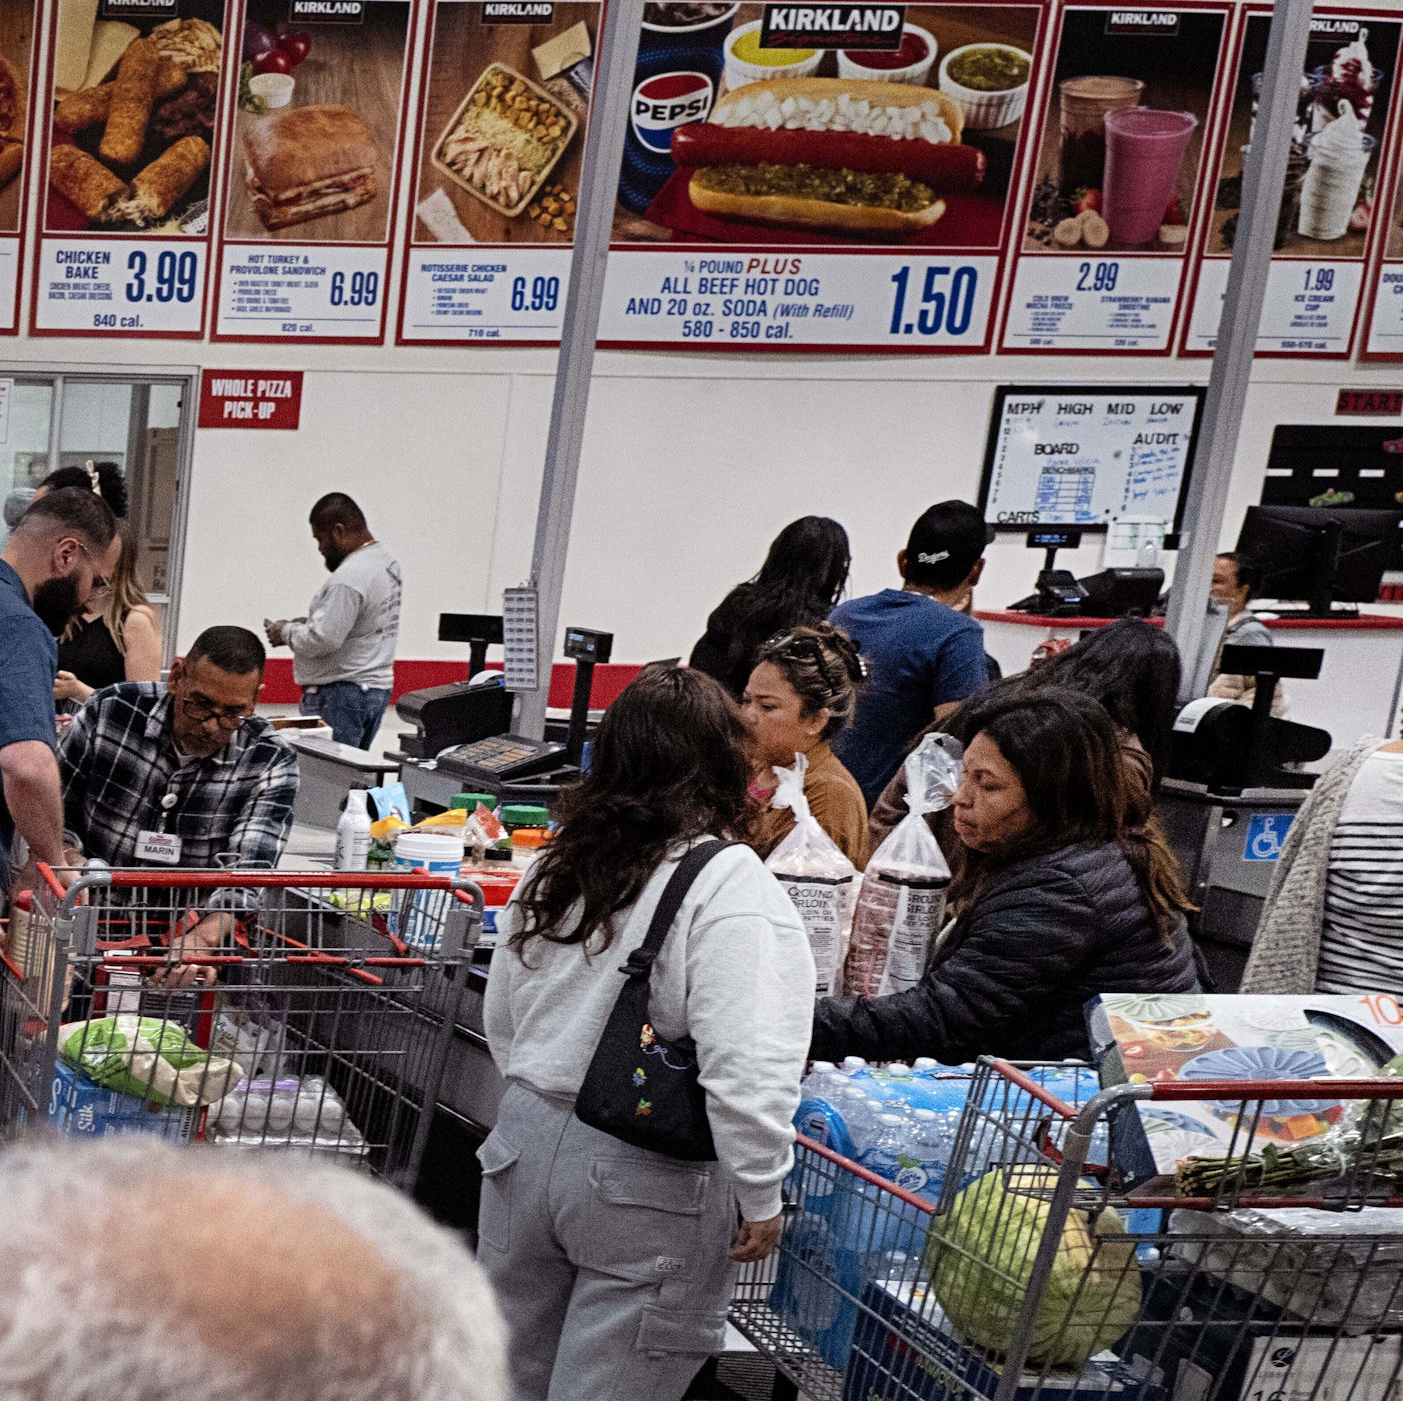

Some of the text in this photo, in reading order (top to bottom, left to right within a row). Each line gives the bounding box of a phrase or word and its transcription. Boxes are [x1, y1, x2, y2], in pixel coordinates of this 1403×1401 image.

[294, 3, 361, 15] KIRKLAND
[484, 4, 552, 16] KIRKLAND
[768, 8, 900, 31] KIRKLAND
[1111, 13, 1177, 26] KIRKLAND
[635, 97, 709, 120] PEPSI
[56, 250, 111, 264] CHICKEN
[248, 255, 309, 264] HOT TURKEY &
[65, 266, 99, 279] BAKE
[229, 266, 326, 275] PROVOLONE SANDWICH
[421, 264, 468, 272] ROTISSERIE
[699, 261, 743, 274] POUND
[746, 259, 802, 275] PLUS
[125, 250, 198, 303] 3.99
[432, 274, 464, 282] CAESAR
[1076, 262, 1119, 291] 2.99
[1303, 268, 1335, 291] 1.99
[330, 271, 379, 306] 6.99
[511, 276, 559, 311] 6.99
[661, 278, 820, 297] ALL BEEF HOT DOG
[890, 265, 978, 336] 1.50
[1308, 295, 1334, 303] CREAM
[626, 299, 854, 321] AND 20 oz. SODA (With Refill)
[93, 314, 144, 328] 840 cal.
[682, 321, 793, 339] 580 850 cal.
[211, 379, 292, 398] WHOLE PIZZA
[223, 401, 276, 419] PICK-UP
[1007, 403, 1184, 415] MPH HIGH MID LOW
[1134, 432, 1180, 445] AUDIT
[1035, 443, 1080, 455] BOARD
[997, 511, 1040, 523] CARTS
[144, 846, 174, 855] MARIN
[78, 1103, 95, 1132] Silk
